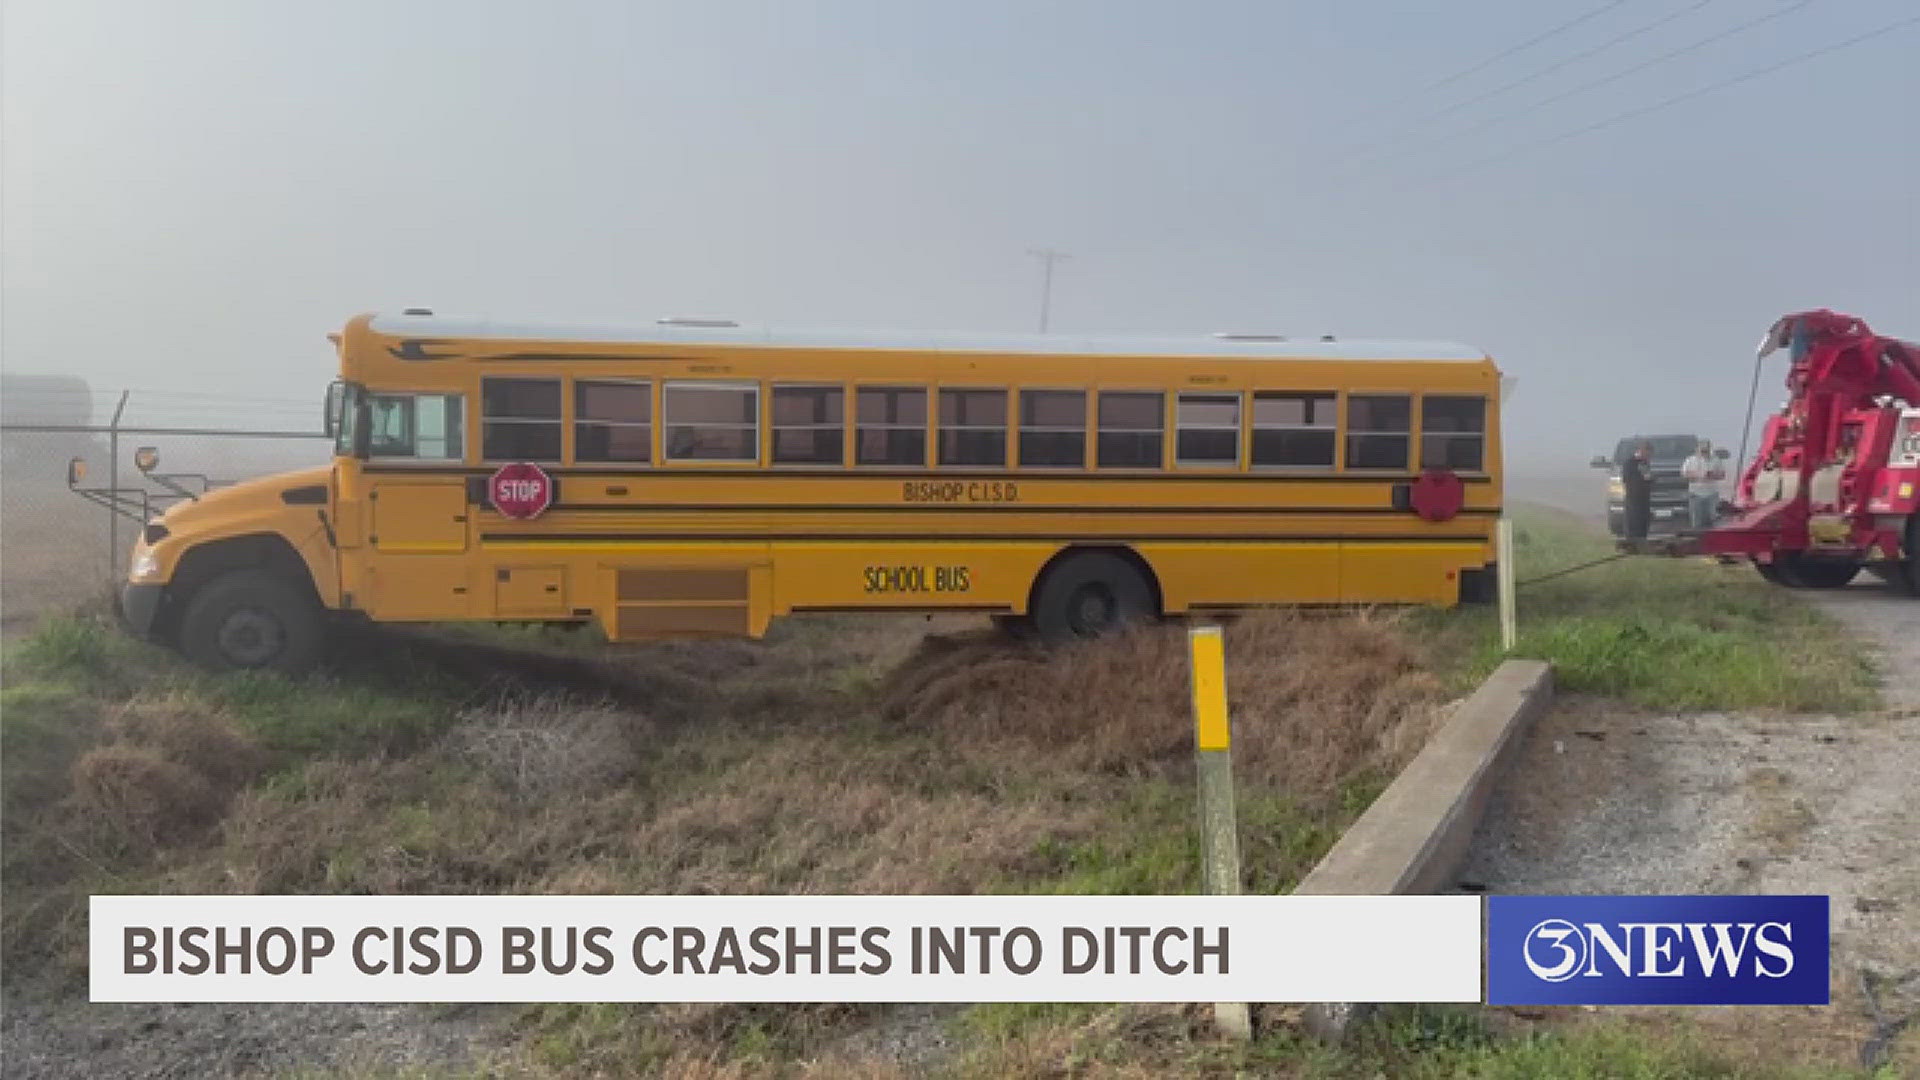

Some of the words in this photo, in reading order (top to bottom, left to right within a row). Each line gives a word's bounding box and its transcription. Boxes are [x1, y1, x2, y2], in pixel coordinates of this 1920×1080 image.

[498, 480, 541, 502] STOP
[904, 482, 963, 502] BISHOP
[864, 566, 930, 592] SCHOOL
[936, 566, 970, 592] BUS
